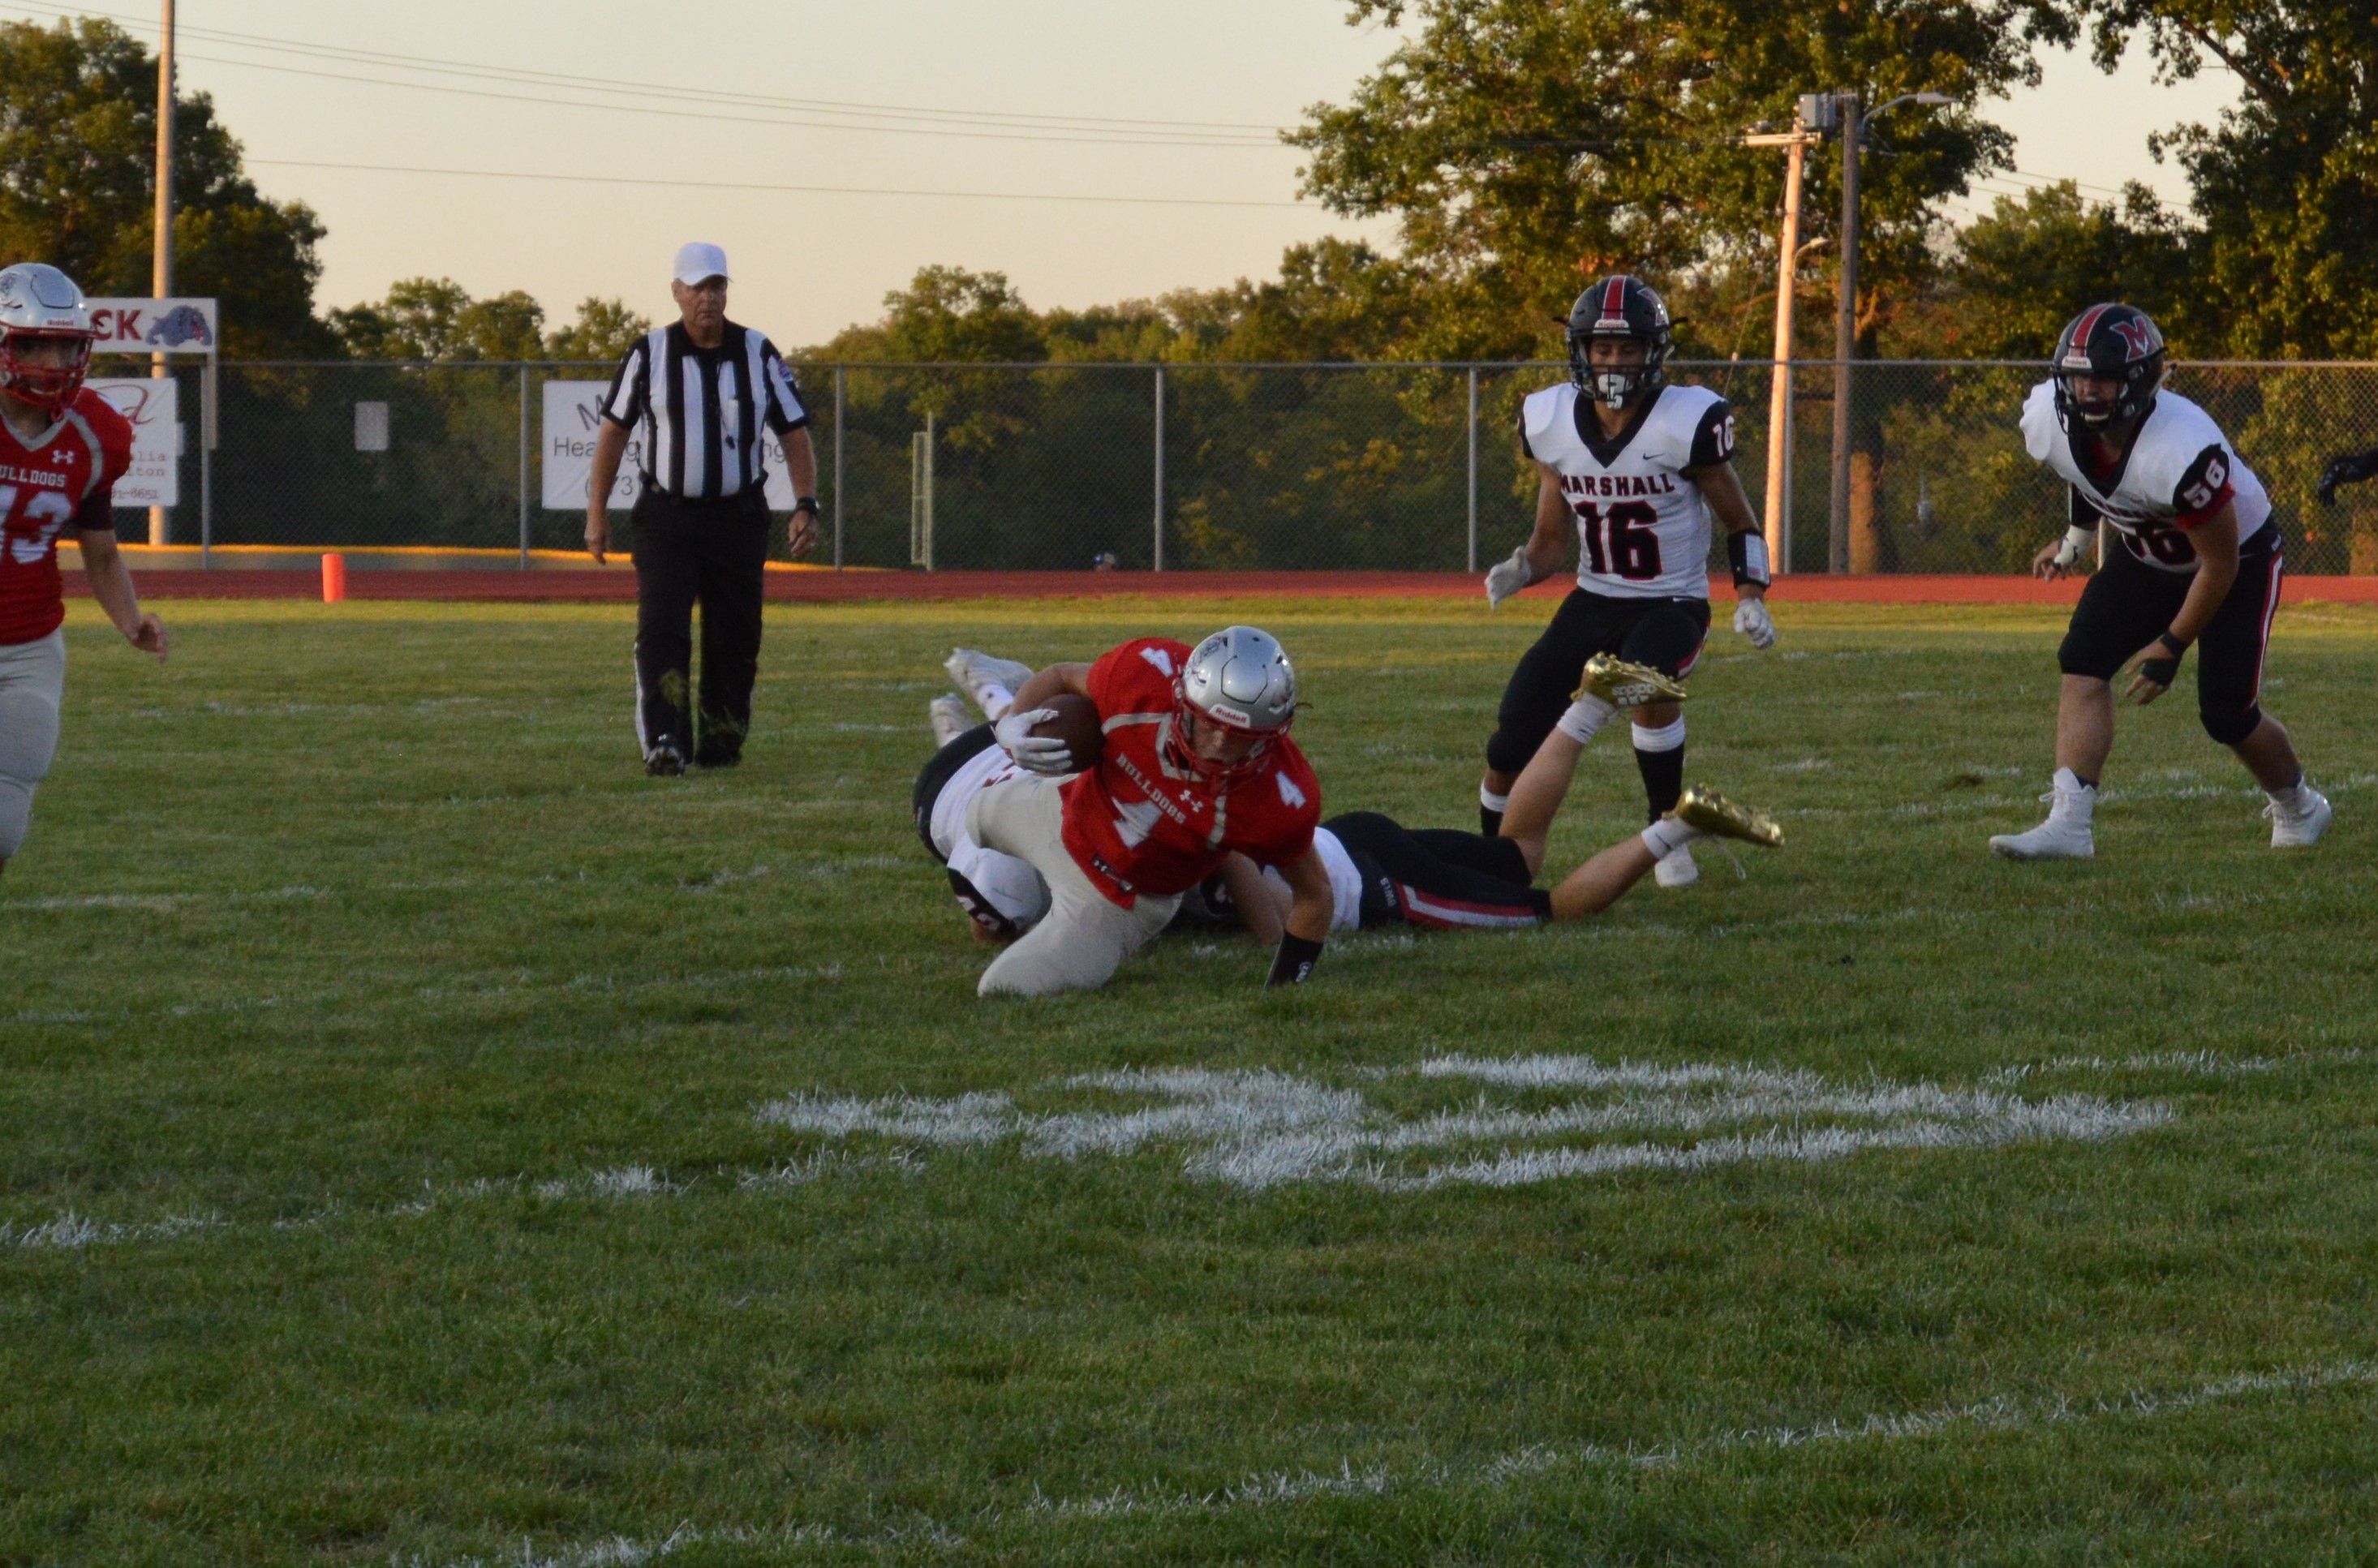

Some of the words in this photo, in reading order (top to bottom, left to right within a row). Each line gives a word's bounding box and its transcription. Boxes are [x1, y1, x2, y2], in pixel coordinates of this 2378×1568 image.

[1713, 415, 1735, 457] 16
[1560, 472, 1675, 496] MARSHALL
[2183, 458, 2225, 510] 56
[1574, 500, 1662, 581] 16
[1116, 753, 1186, 824] BULLDOGS
[1275, 771, 1306, 810] 4
